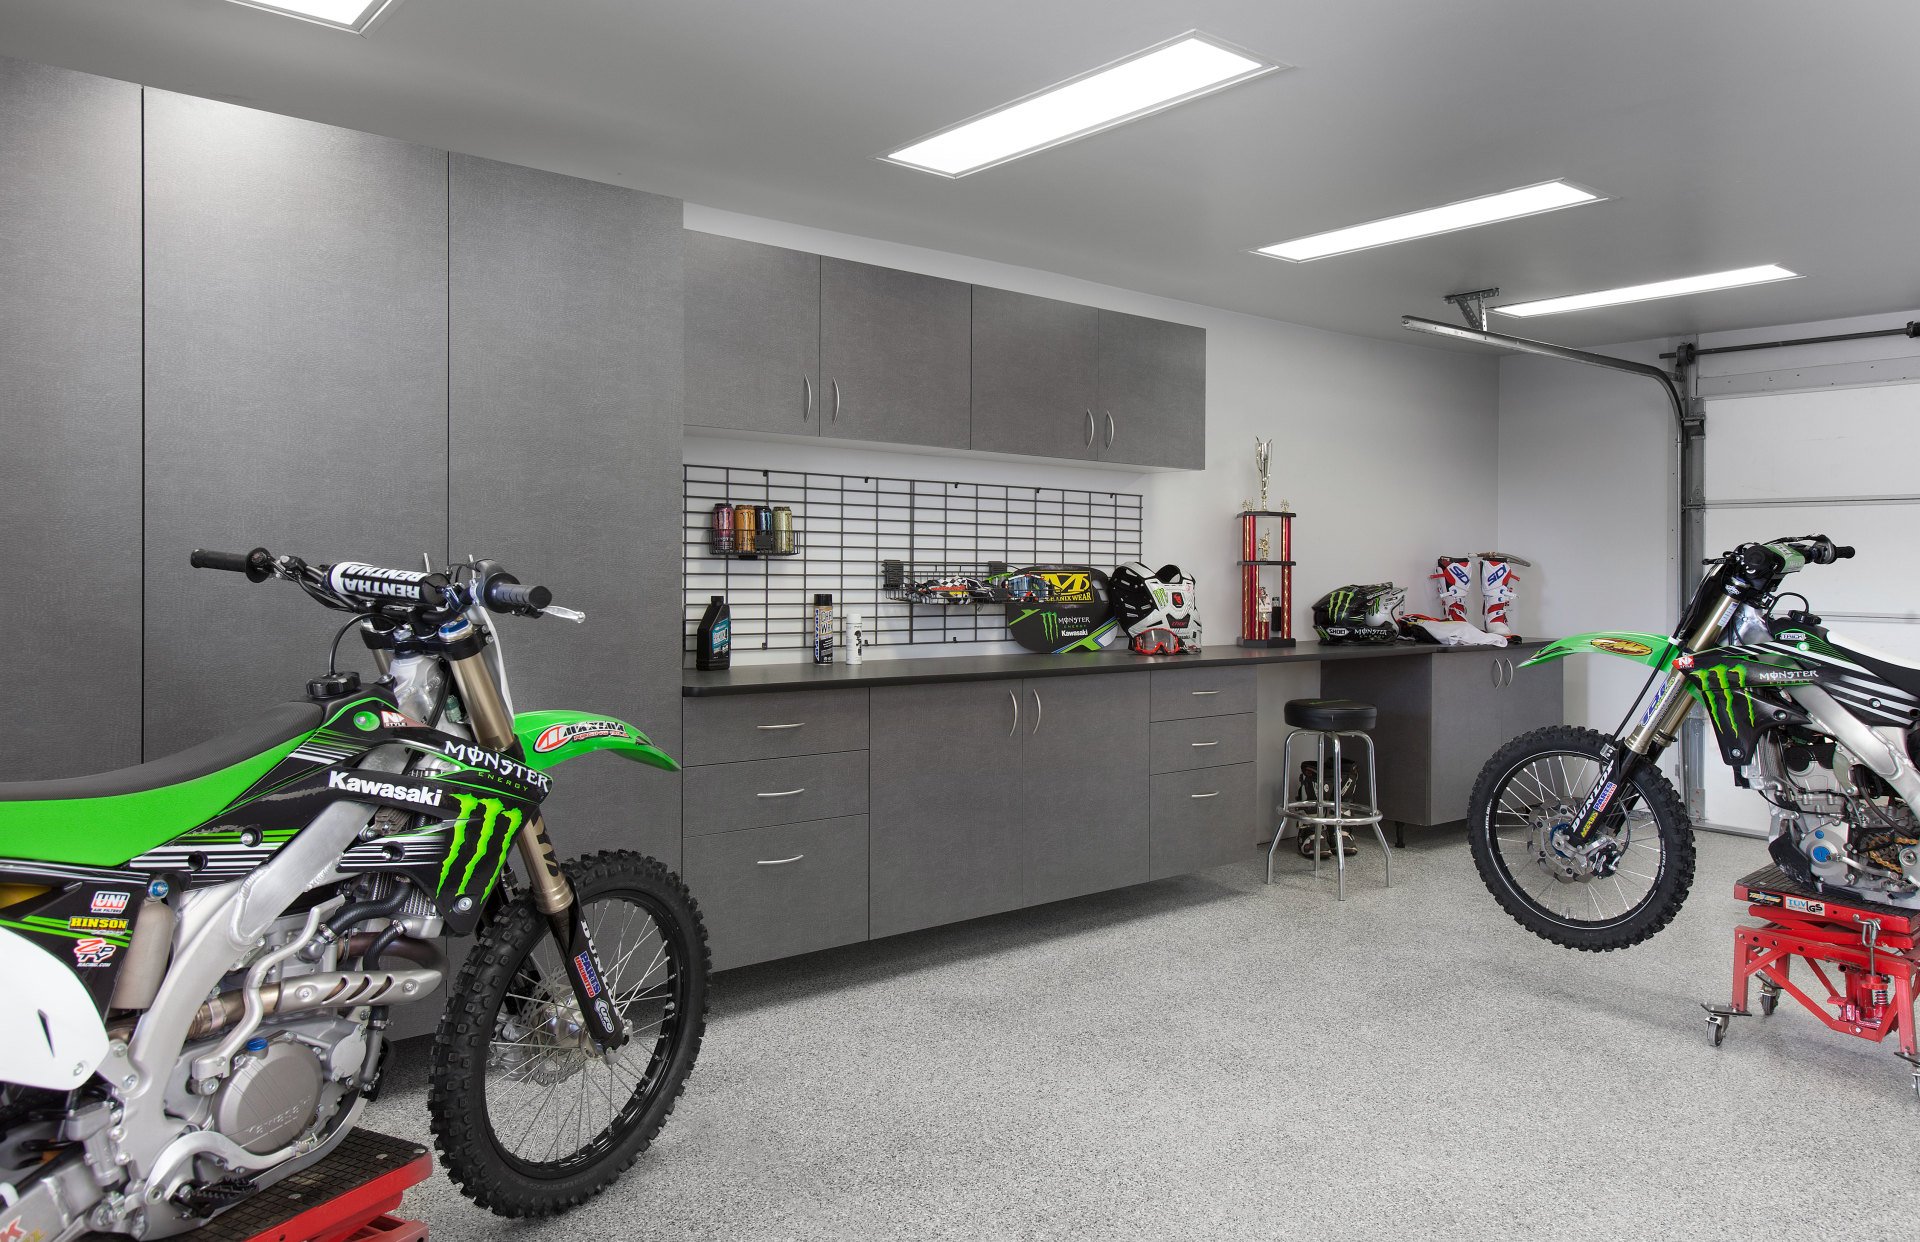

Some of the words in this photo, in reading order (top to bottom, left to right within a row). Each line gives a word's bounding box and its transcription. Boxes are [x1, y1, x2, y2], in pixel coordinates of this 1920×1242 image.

[1071, 592, 1092, 601] WEAR
[1058, 616, 1091, 624] MONSTER
[1061, 629, 1089, 637] Kawasaki
[1759, 670, 1819, 681] MONSTER
[444, 740, 549, 793] MONSTER
[328, 770, 443, 807] Kawasaki
[478, 771, 529, 792] ENERGY
[1571, 759, 1615, 833] DUNLOP
[96, 893, 126, 908] UNI
[70, 917, 128, 930] HINSON
[574, 955, 595, 998] UNLIMITED
[580, 951, 601, 995] PARTS
